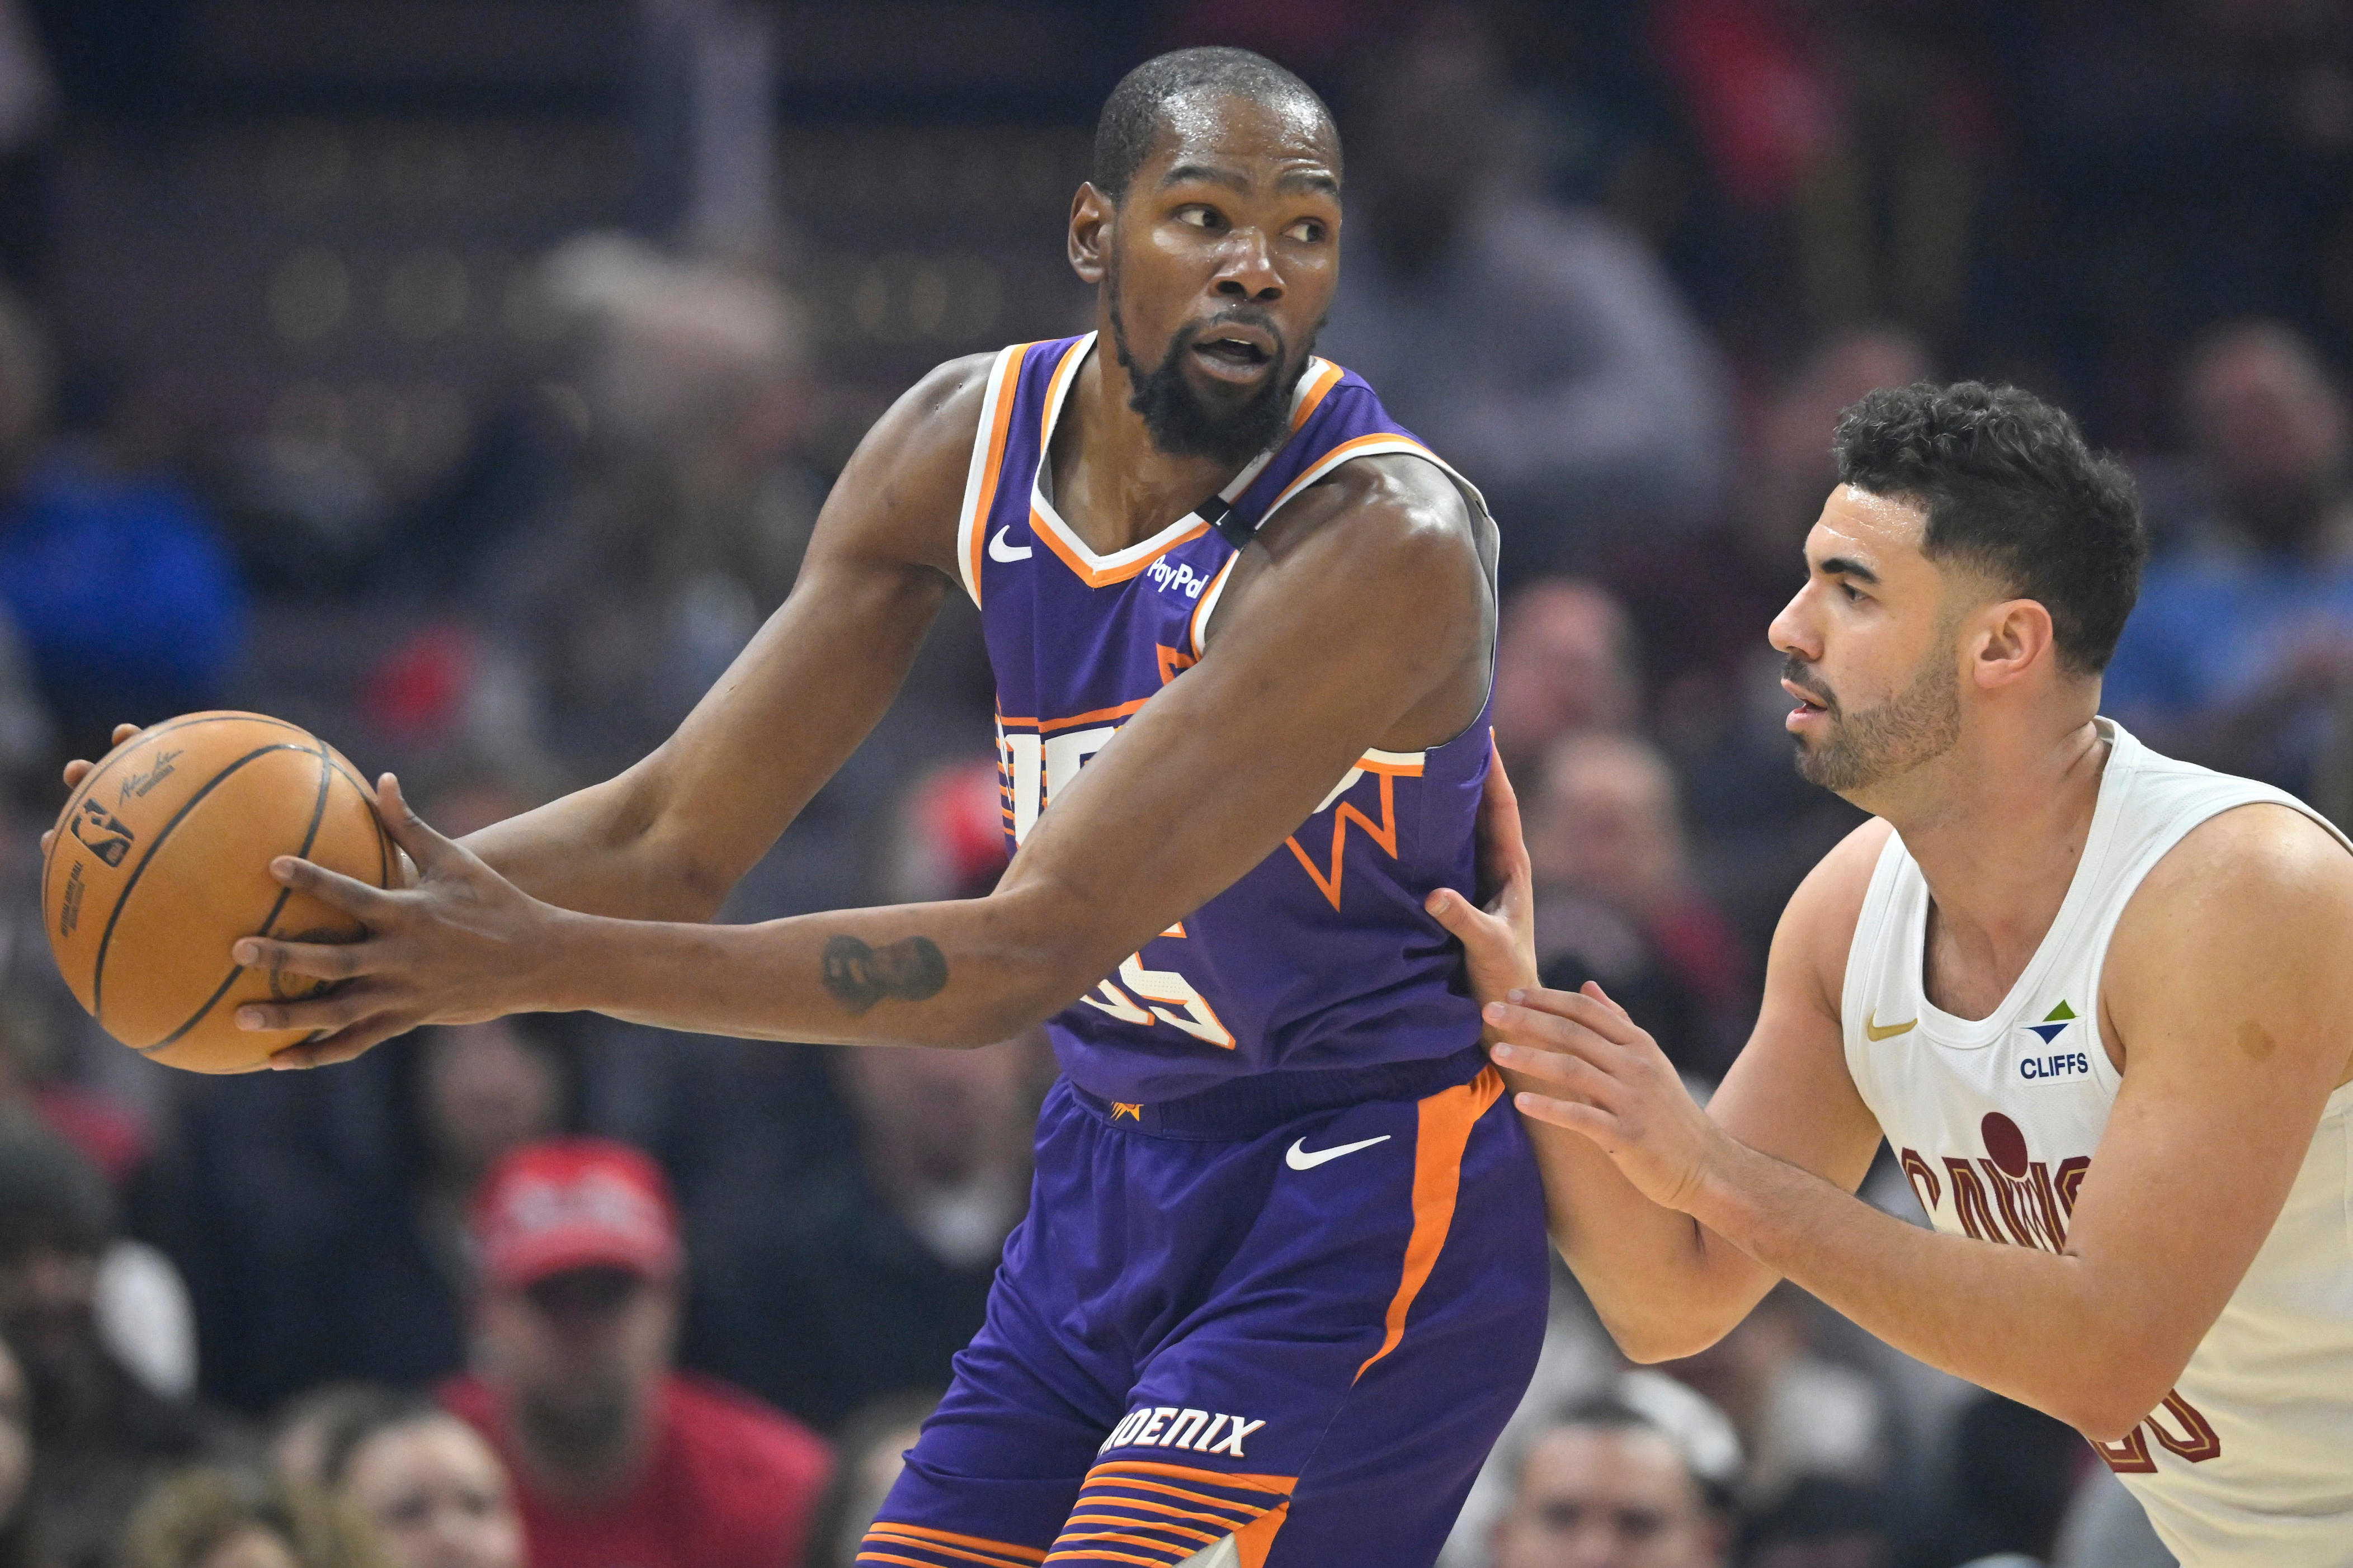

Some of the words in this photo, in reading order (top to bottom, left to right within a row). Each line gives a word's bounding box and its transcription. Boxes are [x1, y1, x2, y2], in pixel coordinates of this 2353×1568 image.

[1147, 554, 1209, 599] PayPal
[2020, 1052, 2088, 1079] CLIFFS
[1097, 1407, 1266, 1457] HOENIX
